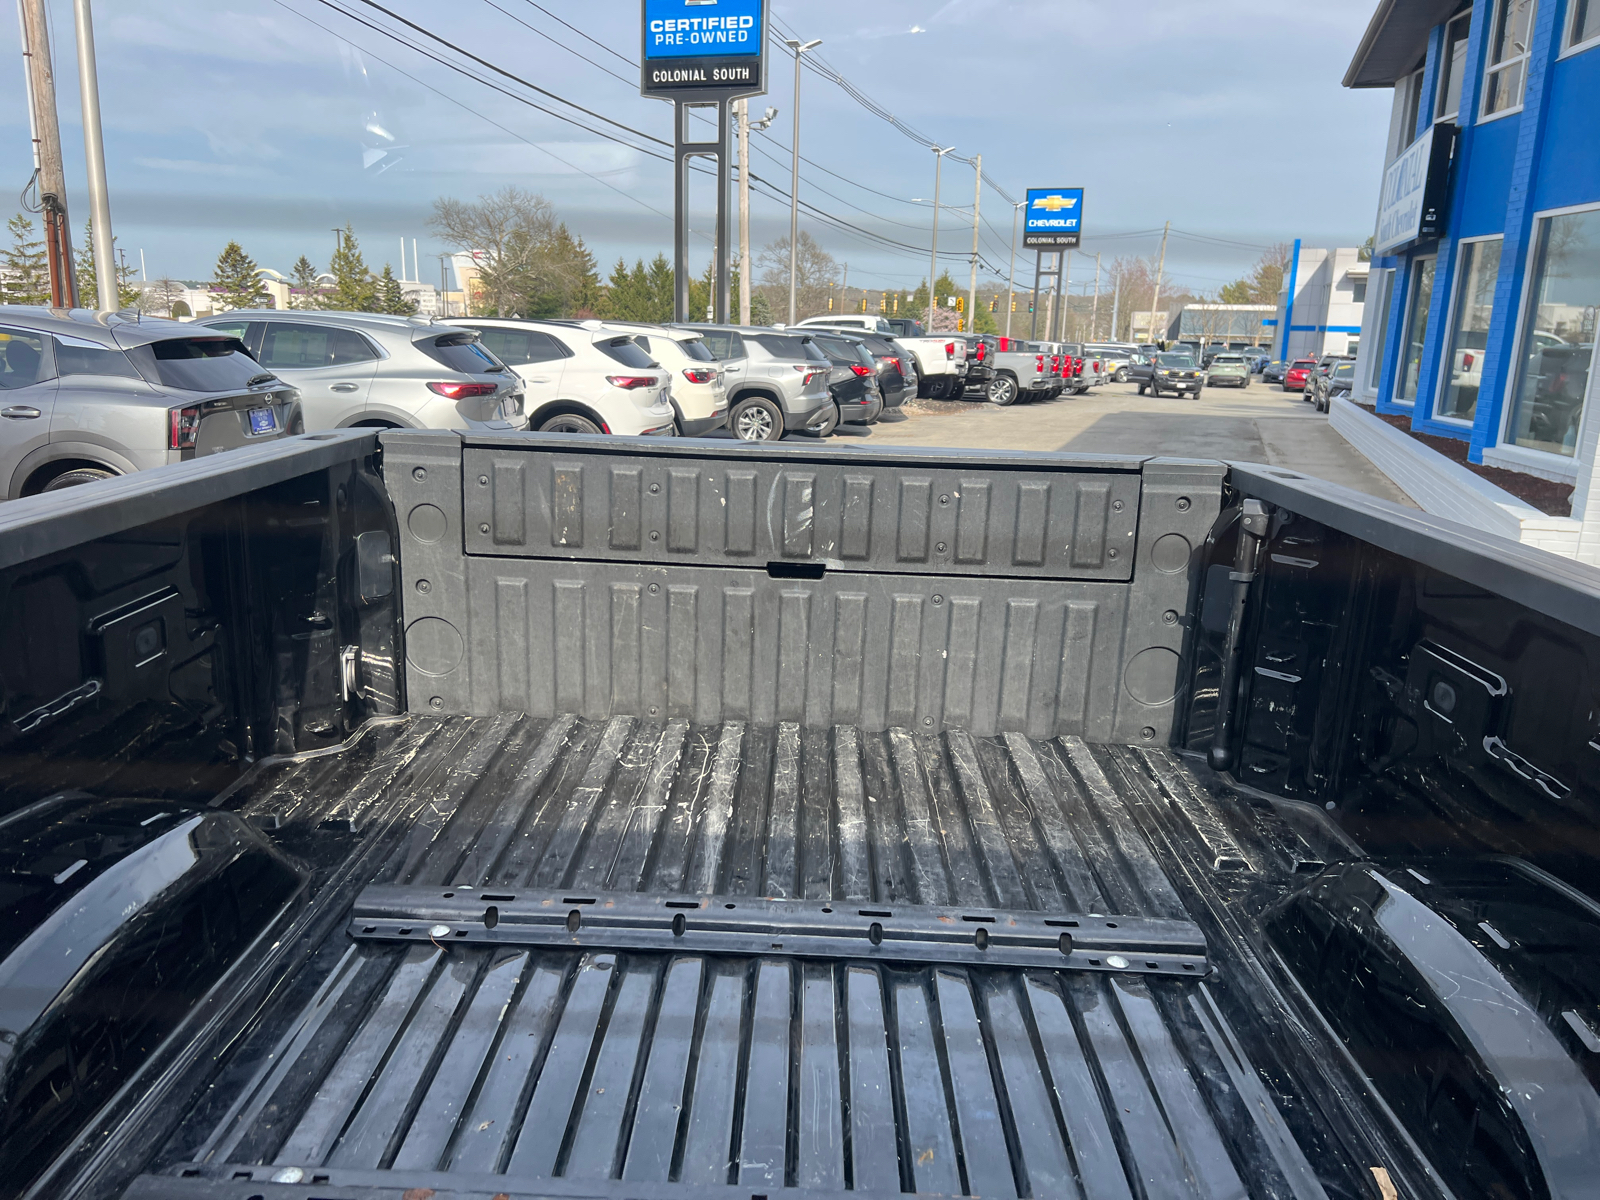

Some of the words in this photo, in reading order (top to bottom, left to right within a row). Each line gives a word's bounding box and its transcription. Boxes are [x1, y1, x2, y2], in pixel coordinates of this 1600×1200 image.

[650, 16, 753, 32] CERTIFIED
[655, 30, 748, 46] PRE-OWNED
[652, 69, 707, 82] COLONIAL
[713, 67, 750, 80] SOUTH
